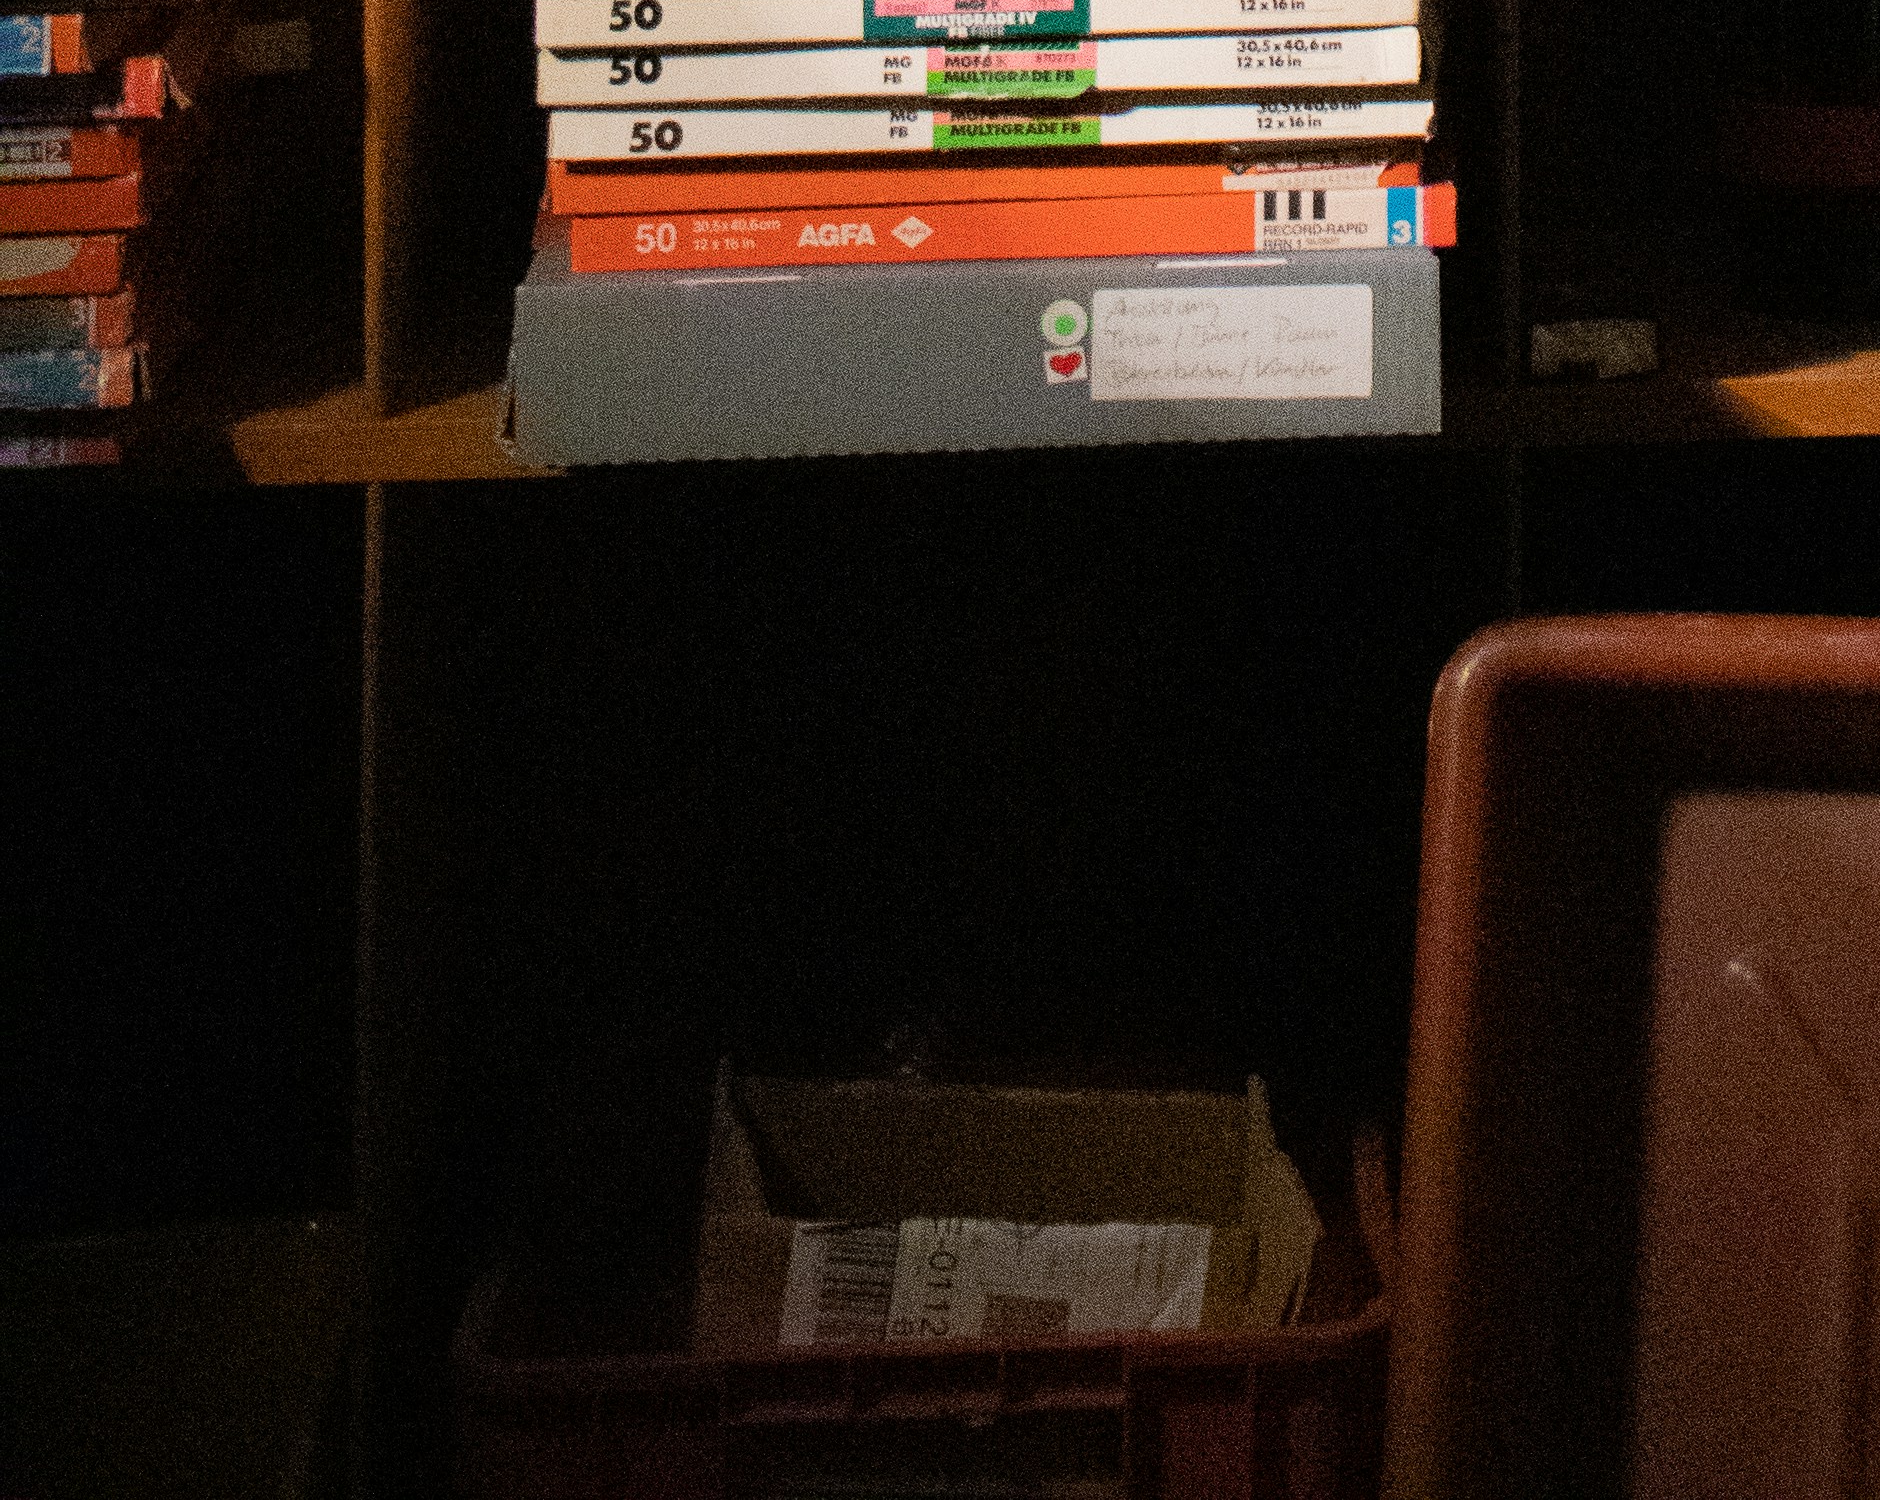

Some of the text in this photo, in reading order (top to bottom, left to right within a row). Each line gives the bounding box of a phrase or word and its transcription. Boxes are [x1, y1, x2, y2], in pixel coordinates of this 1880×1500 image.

[1239, 0, 1257, 12] 12
[1260, 0, 1269, 11] x
[1236, 39, 1271, 54] 30,5
[1273, 43, 1282, 52] x
[1321, 40, 1343, 52] cm
[883, 56, 912, 69] MG
[1236, 55, 1302, 69] 12 x 16 in
[609, 54, 663, 86] 50
[944, 70, 1076, 84] MULTIGRADE FB
[883, 72, 903, 85] FB
[950, 122, 1082, 137] MULTIGRADE FB
[1256, 115, 1323, 130] 12 x 16 in
[629, 120, 683, 152] 50
[889, 126, 909, 139] FB
[797, 222, 878, 248] AGFA
[1263, 221, 1369, 236] RECORD-RAPID
[1391, 219, 1414, 244] 3
[635, 222, 678, 254] 50
